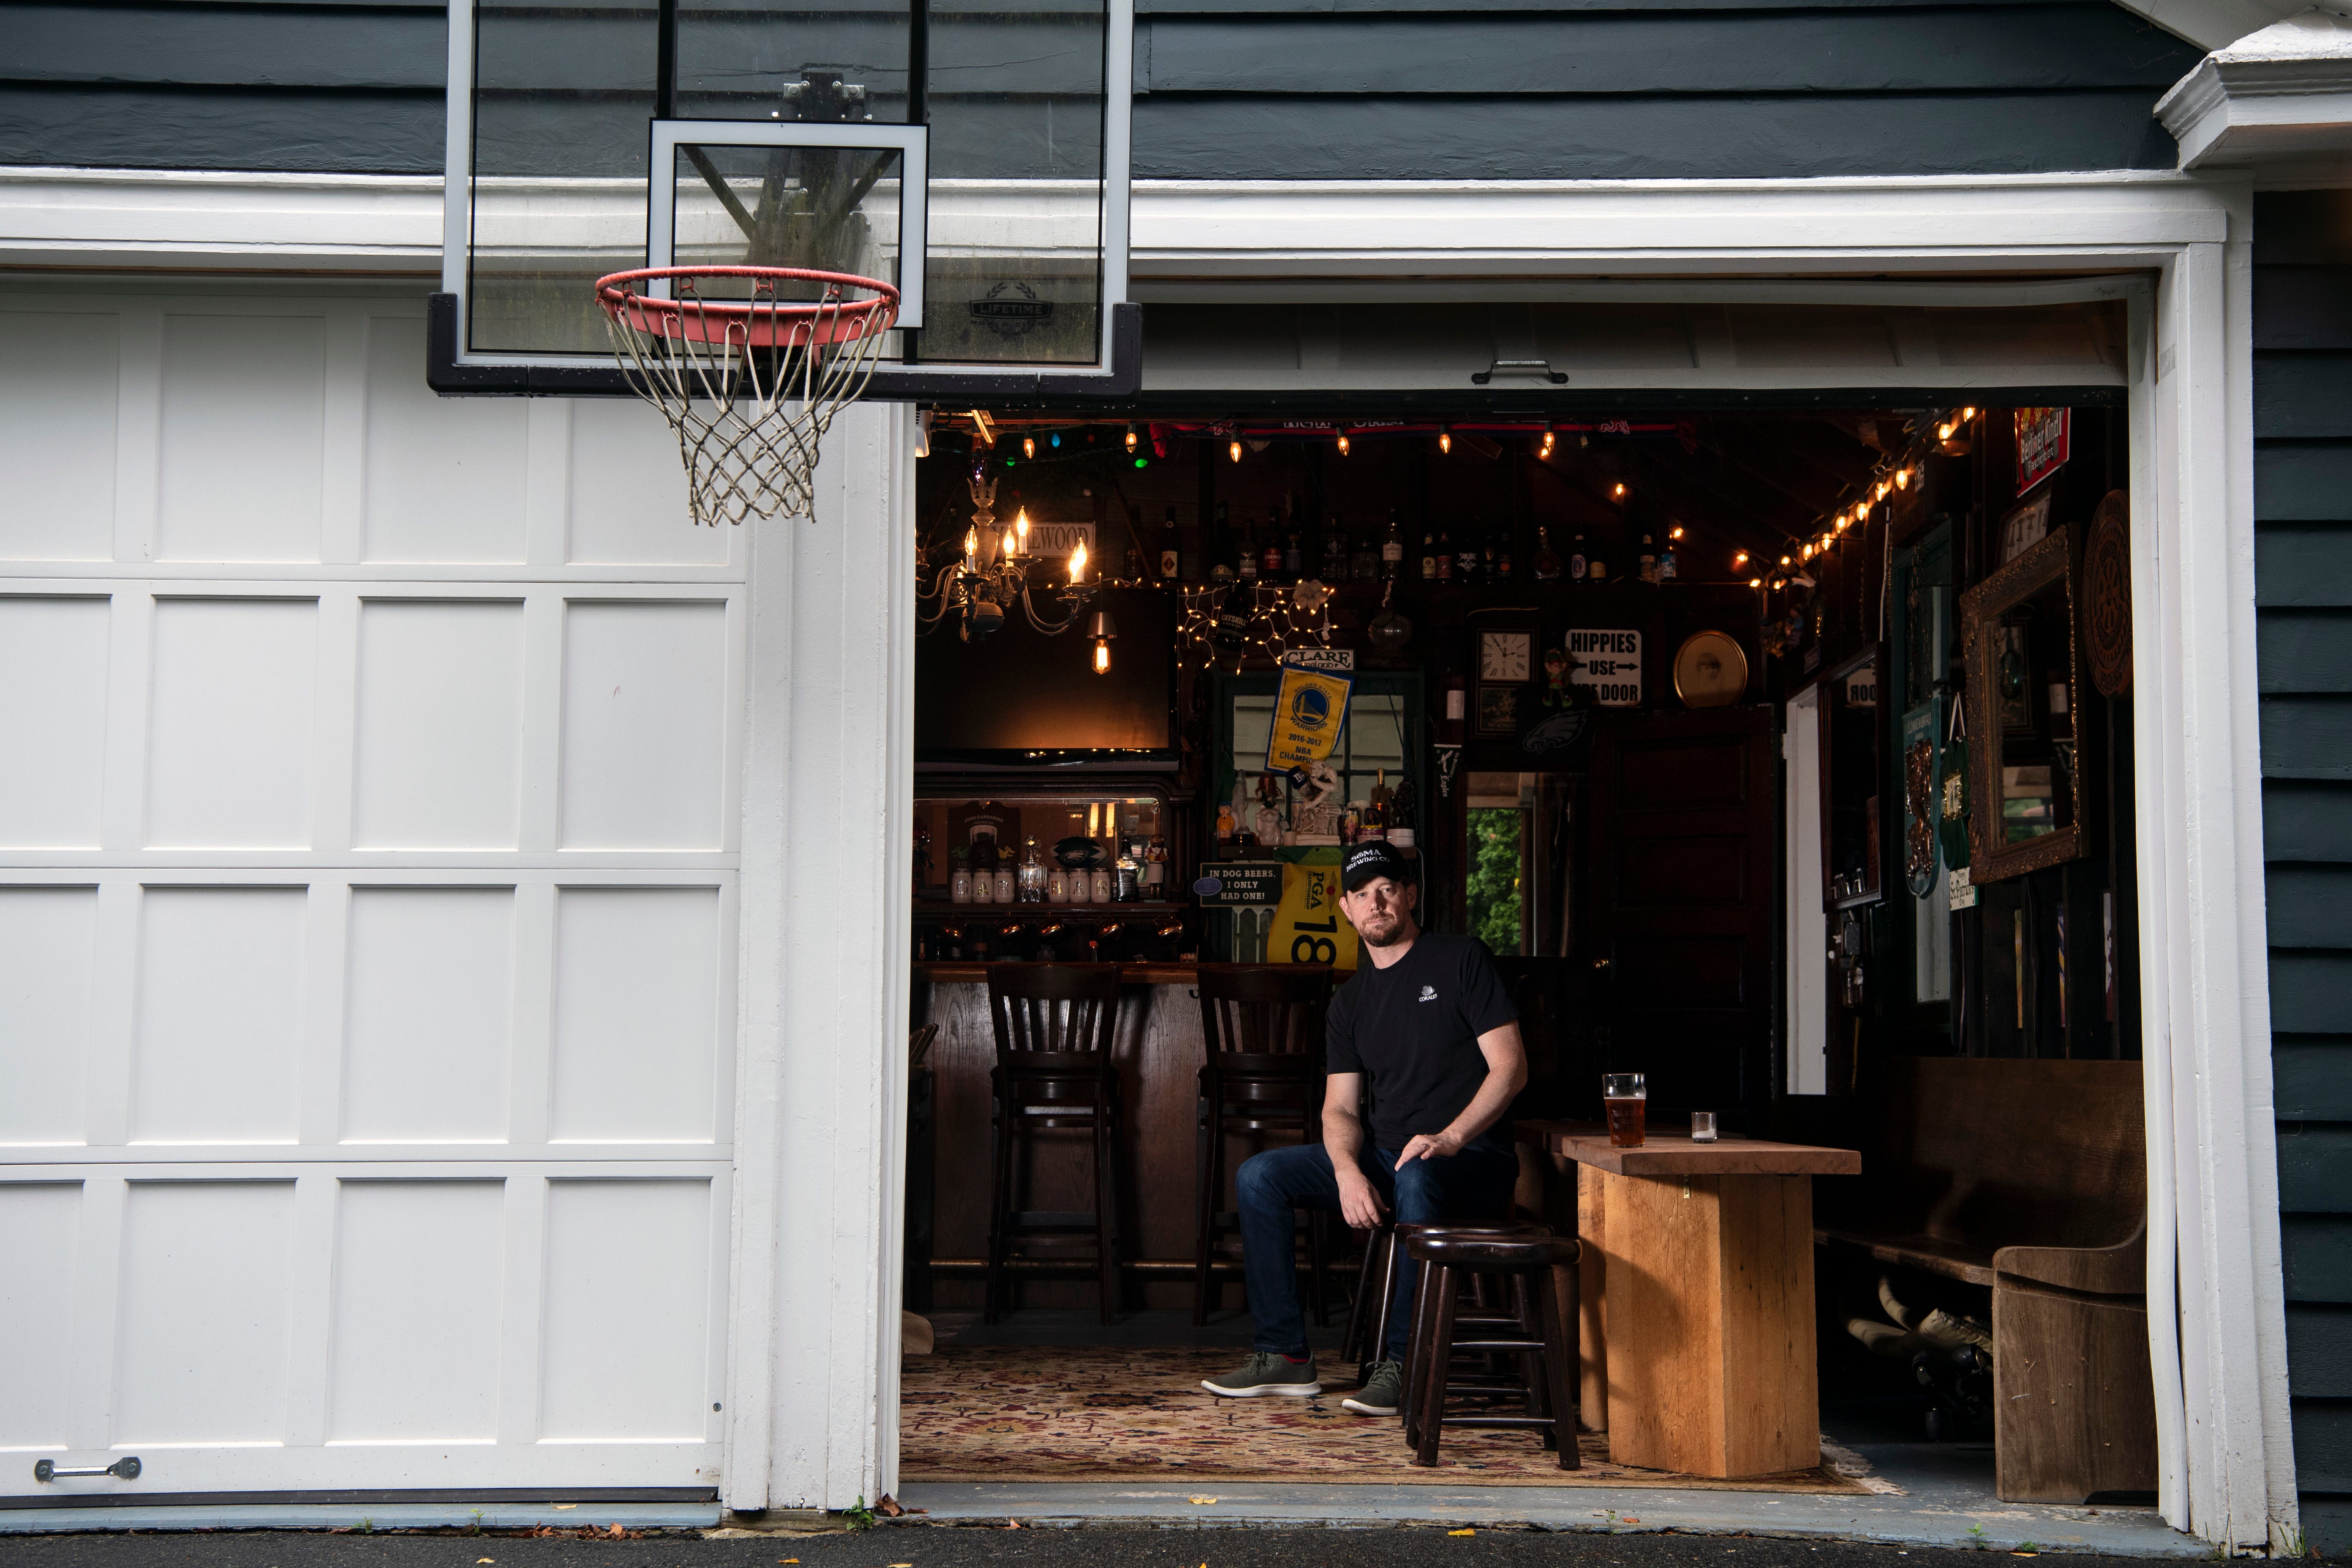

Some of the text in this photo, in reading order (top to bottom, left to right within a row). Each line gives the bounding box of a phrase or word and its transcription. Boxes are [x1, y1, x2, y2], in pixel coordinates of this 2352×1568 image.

[979, 304, 1043, 315] LIFETIME
[2021, 410, 2062, 464] Berliner Kindl
[992, 526, 1089, 550] EWOOD
[1221, 613, 1247, 627] CATSKILL
[1571, 633, 1636, 653] HIPPIES
[1286, 651, 1351, 668] CLARE
[1589, 660, 1616, 675] USE
[1294, 683, 1333, 700] GOLDEN STATE
[1601, 684, 1638, 701] DOOR
[1290, 715, 1328, 732] WARRIORS
[1288, 733, 1322, 746] 2016-2017
[1295, 746, 1311, 756] NBA
[964, 814, 1004, 824] JOHN GARBARINO
[1346, 856, 1378, 872] BREWING
[1351, 849, 1382, 863] SOMA
[1244, 870, 1276, 878] BEERS,
[1310, 871, 1325, 910] PGA
[1291, 915, 1338, 967] 18
[1419, 993, 1438, 1002] CORALES
